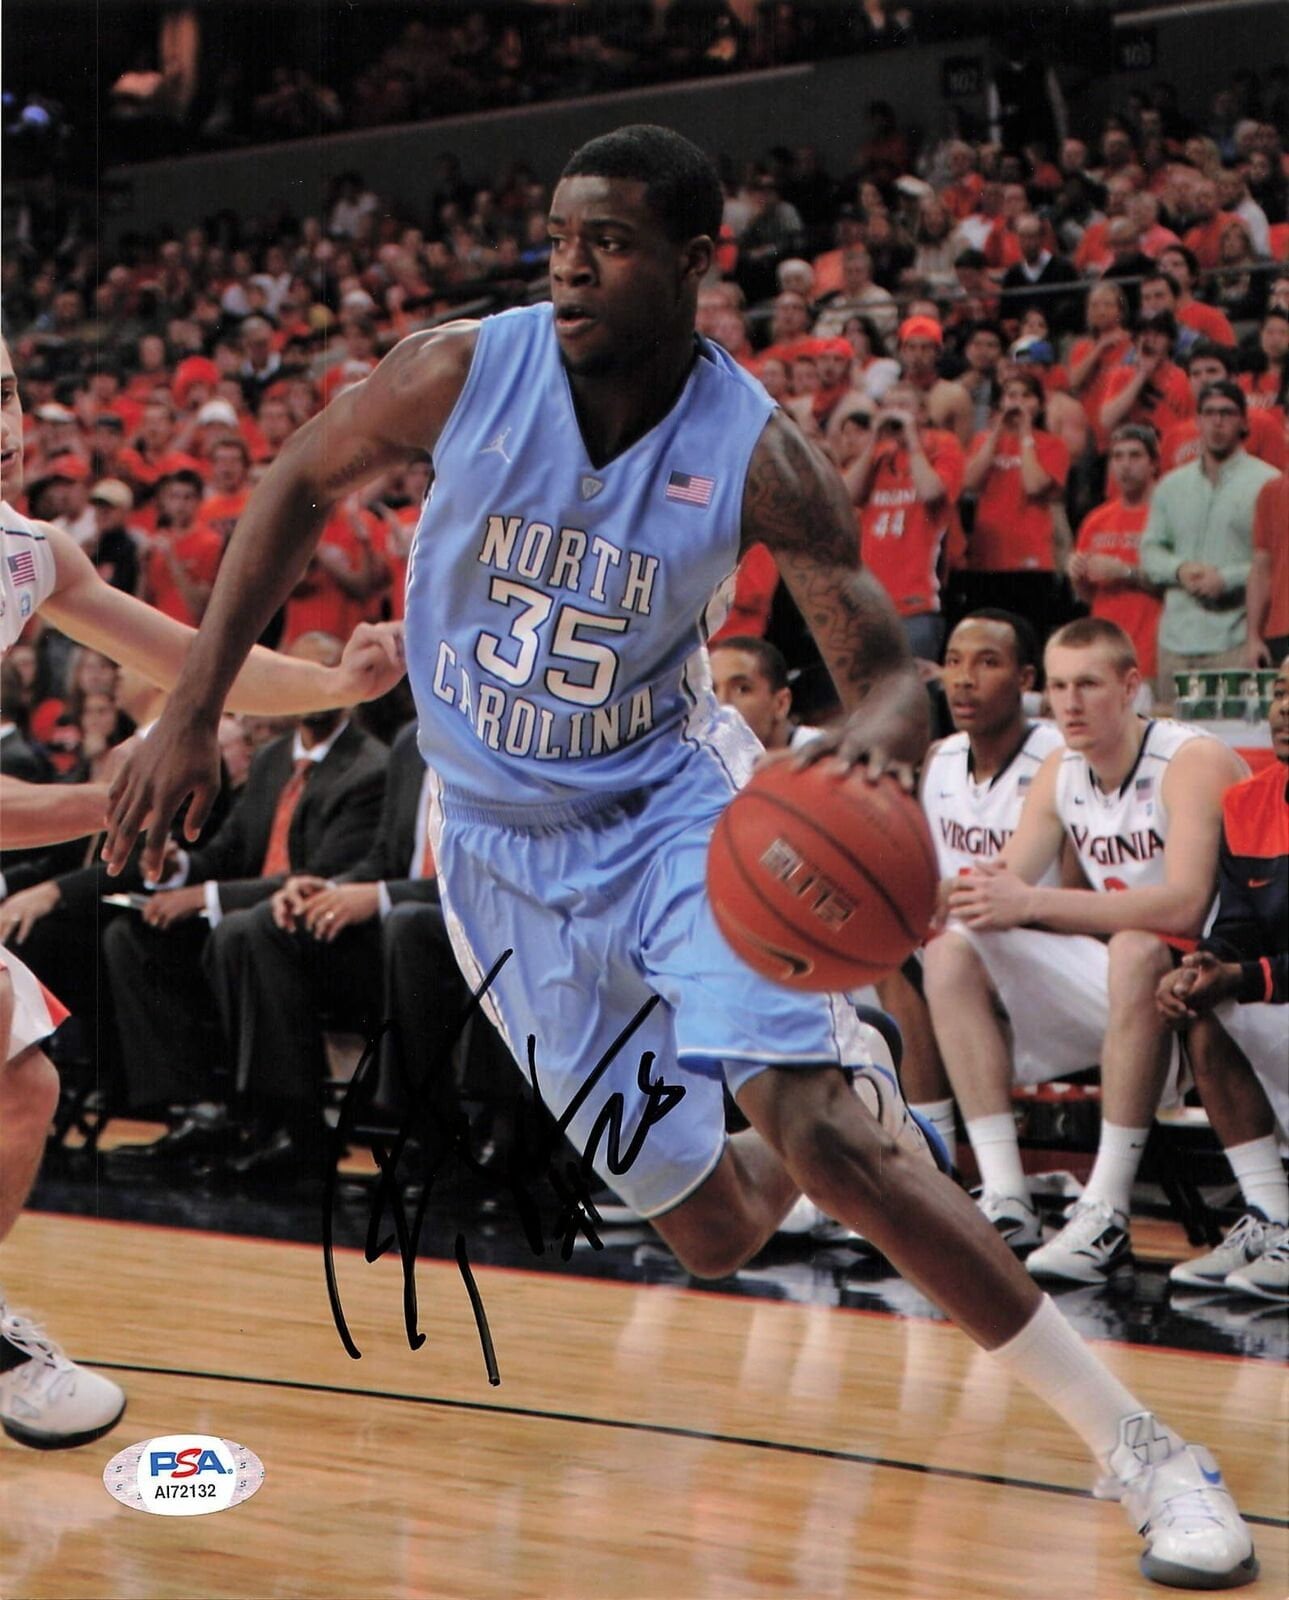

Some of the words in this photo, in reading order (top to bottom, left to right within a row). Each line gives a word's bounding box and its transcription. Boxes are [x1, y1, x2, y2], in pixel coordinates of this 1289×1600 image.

[872, 510, 905, 540] 44
[477, 514, 660, 615] NORTH
[473, 576, 630, 708] 35
[432, 640, 655, 761] CAROLINA
[940, 817, 1014, 856] VIRGIN
[1071, 823, 1165, 866] VGINIA
